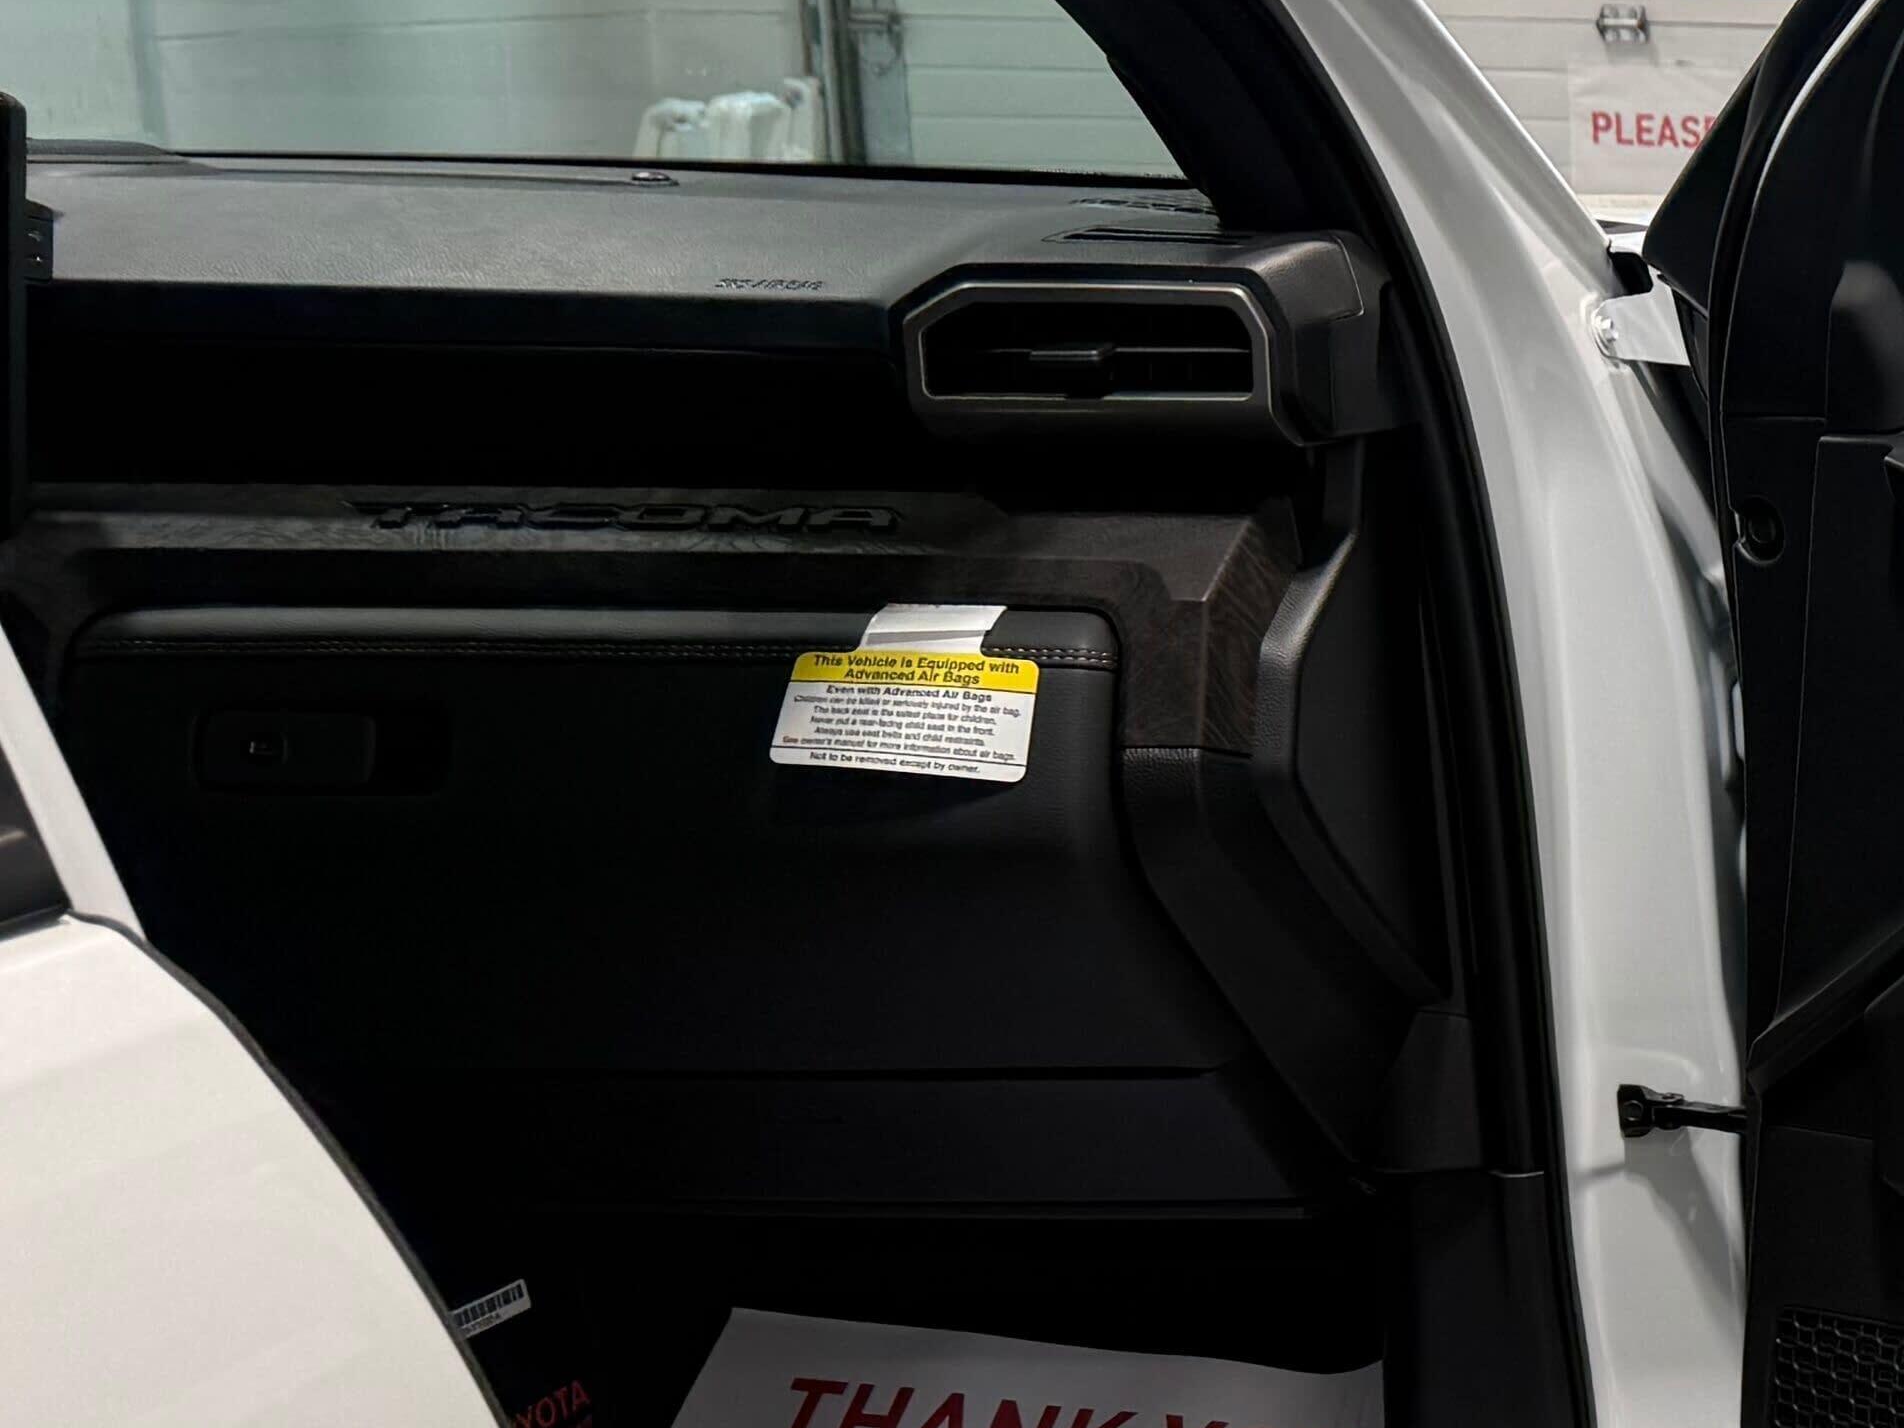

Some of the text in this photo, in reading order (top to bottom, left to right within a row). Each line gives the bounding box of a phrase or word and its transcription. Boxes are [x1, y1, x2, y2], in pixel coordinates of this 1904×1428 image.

[341, 498, 904, 535] TACOMA
[814, 655, 1019, 673] This Vehicle is Equipped with
[845, 669, 980, 686] Advanced Air Bags
[826, 685, 992, 702] Even with Advanced Air Bags
[934, 761, 945, 771] by
